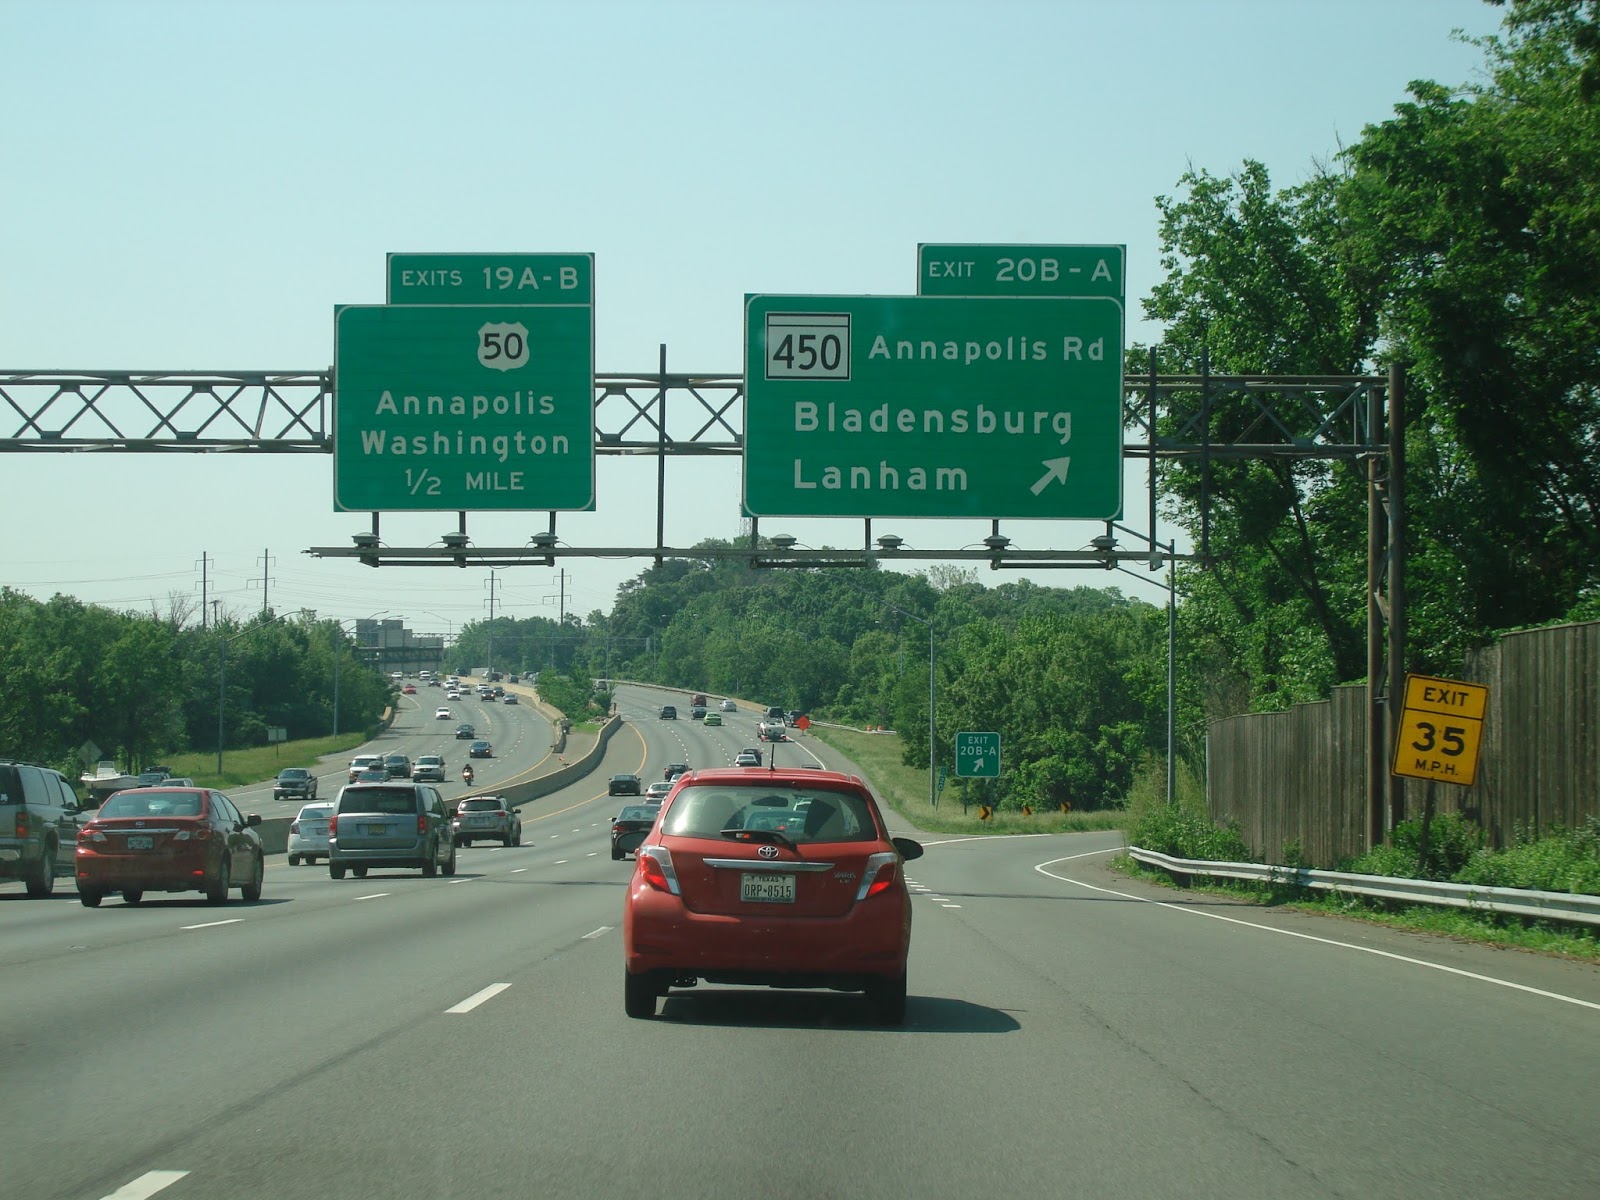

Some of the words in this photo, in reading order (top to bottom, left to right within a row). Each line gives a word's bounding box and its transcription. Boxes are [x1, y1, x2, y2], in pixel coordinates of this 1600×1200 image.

[402, 270, 463, 286] EXITS
[929, 261, 975, 277] EXIT
[483, 333, 523, 360] 50
[773, 334, 842, 370] 450
[868, 335, 1047, 364] Annapolis
[1063, 337, 1104, 361] Rd
[375, 390, 555, 420] Annapolis
[794, 401, 1072, 446] Bladensburg
[361, 430, 569, 463] Washington
[405, 468, 441, 495] 1/2
[465, 472, 524, 490] MILE
[794, 459, 968, 490] Lanham
[1423, 687, 1469, 706] EXIT
[960, 746, 996, 756] 20B-A
[968, 736, 989, 744] EXIT
[1411, 722, 1466, 757] 35
[1415, 758, 1458, 776] M.P.H.
